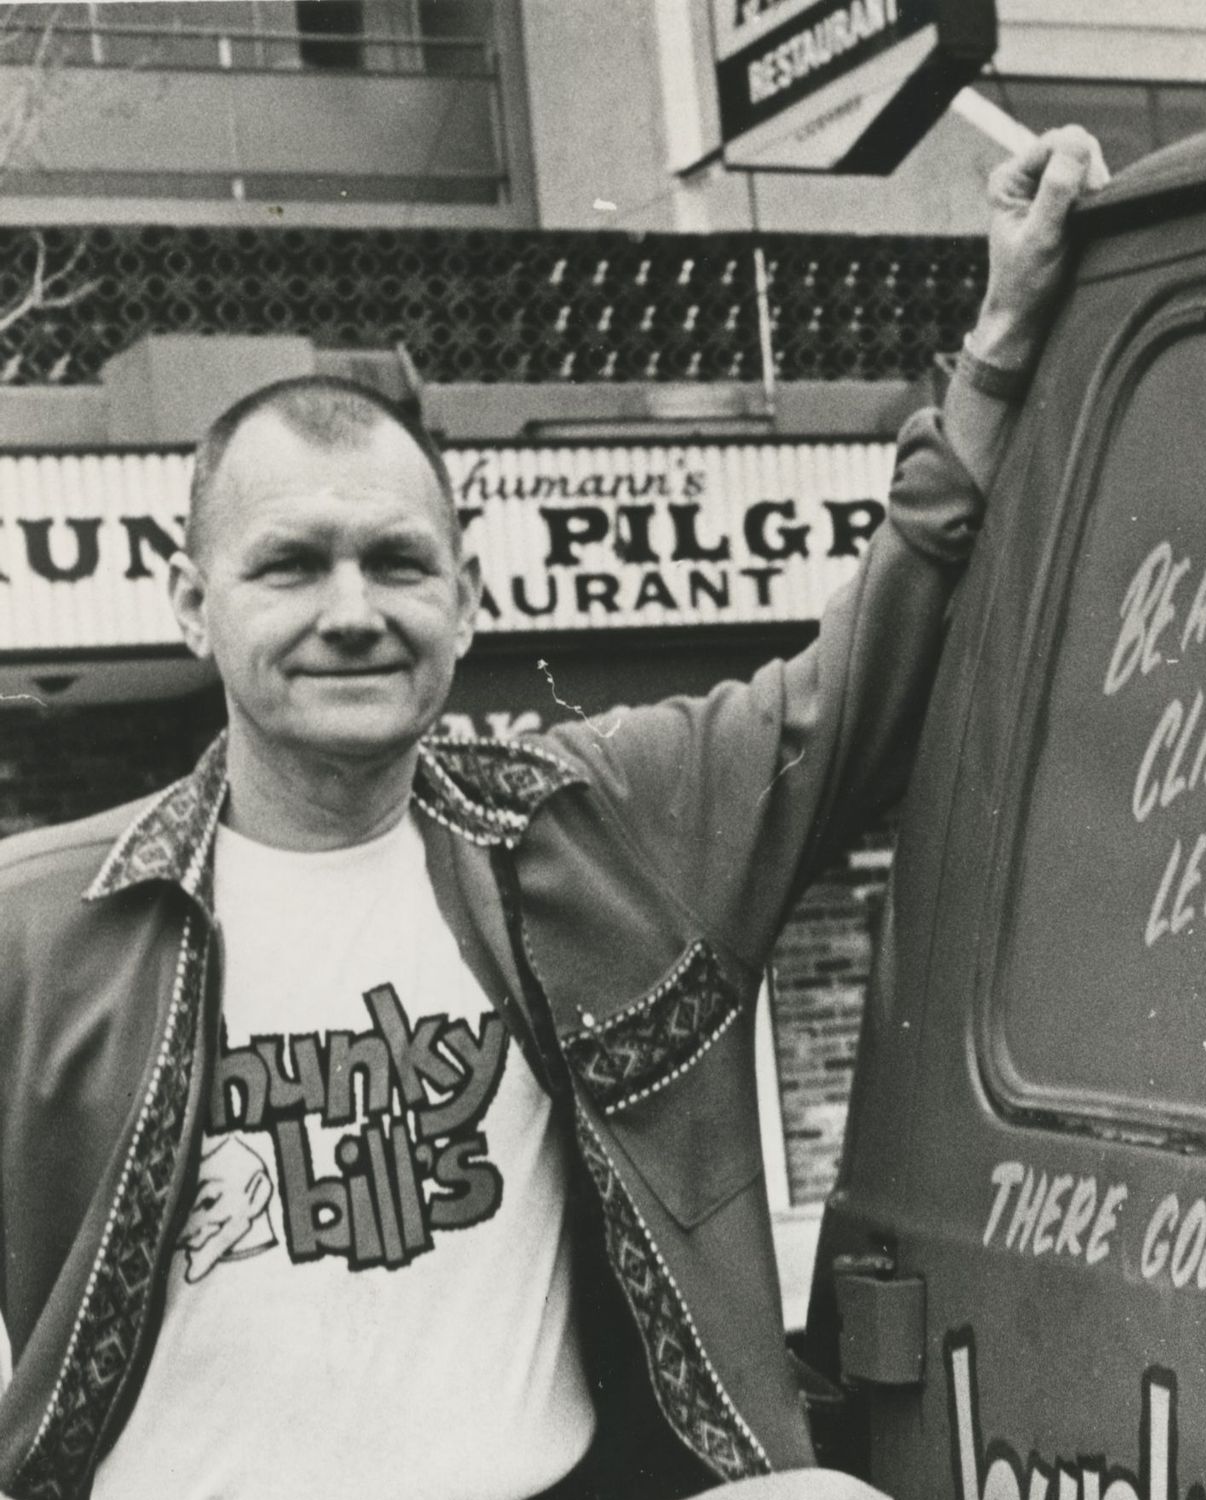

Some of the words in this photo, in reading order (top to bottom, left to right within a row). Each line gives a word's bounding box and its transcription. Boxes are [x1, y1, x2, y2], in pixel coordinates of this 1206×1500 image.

[462, 456, 706, 501] humann's
[538, 500, 886, 567] PILGR
[1104, 541, 1190, 695] BE
[272, 1118, 504, 1272] bill's
[983, 1162, 1128, 1264] THERE
